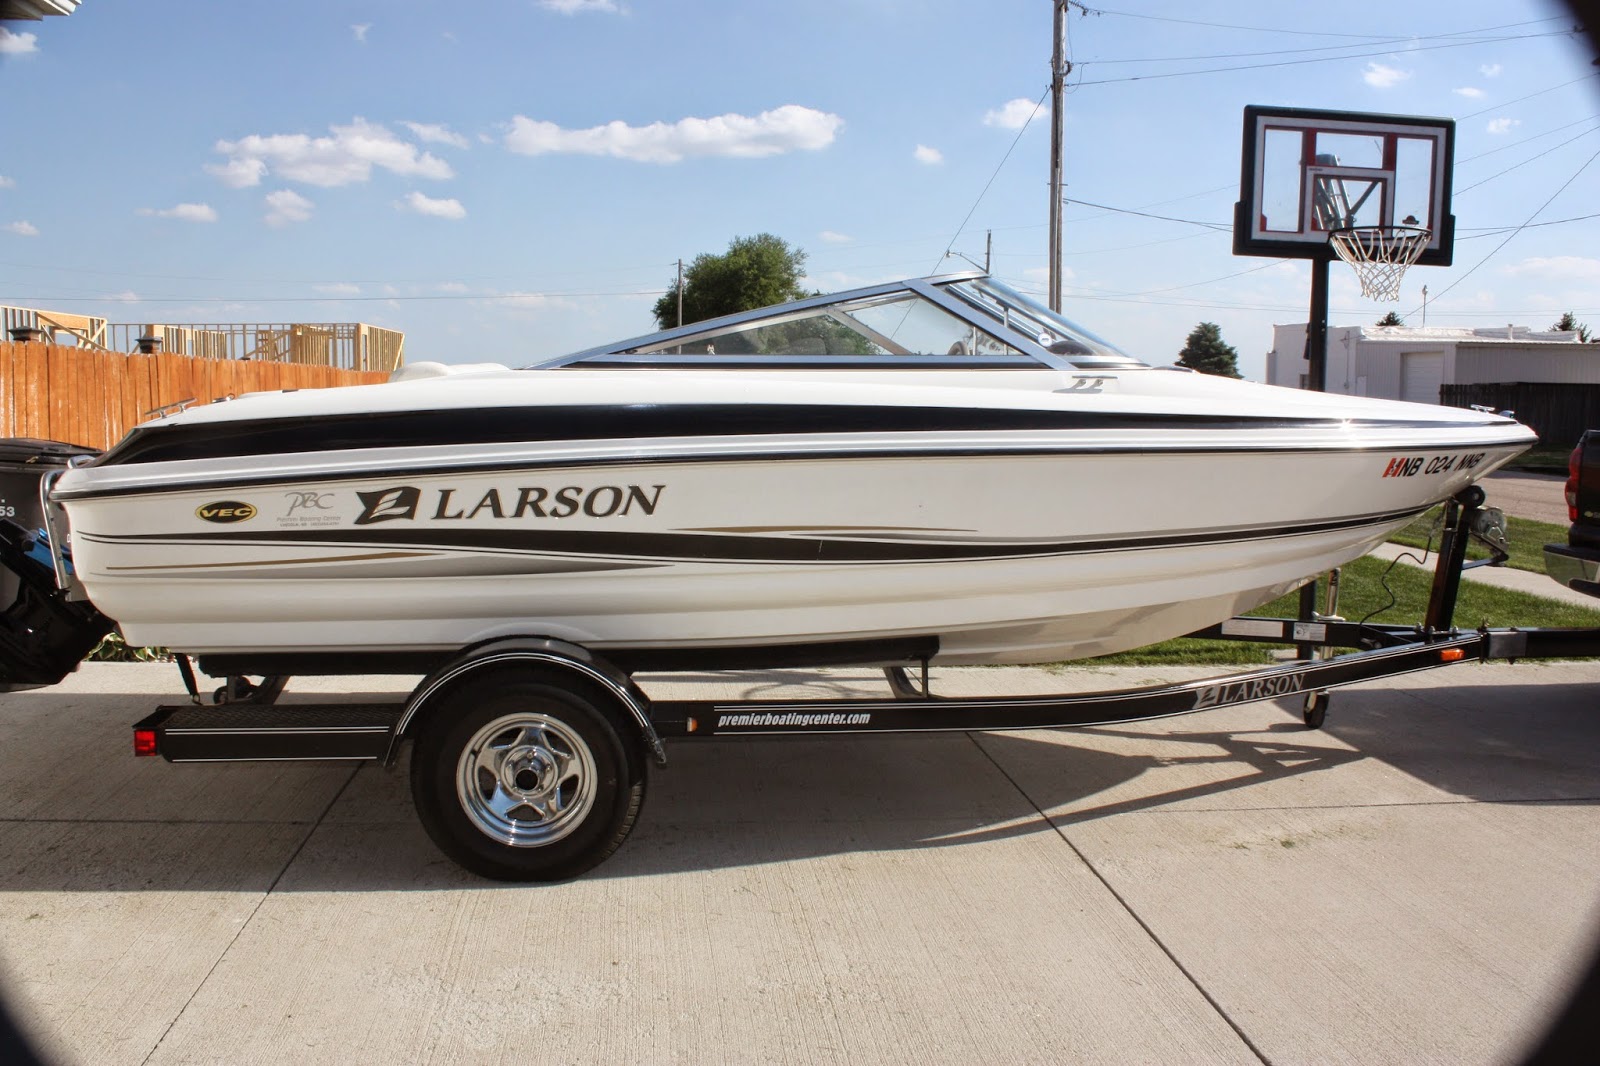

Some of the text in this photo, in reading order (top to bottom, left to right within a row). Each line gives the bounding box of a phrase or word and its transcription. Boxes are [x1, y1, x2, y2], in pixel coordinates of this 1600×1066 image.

[1424, 455, 1458, 475] 024
[431, 484, 666, 520] LARSON
[201, 507, 252, 518] VEC
[1220, 673, 1306, 704] LARSON
[718, 712, 871, 727] premierboatingcenter.com
